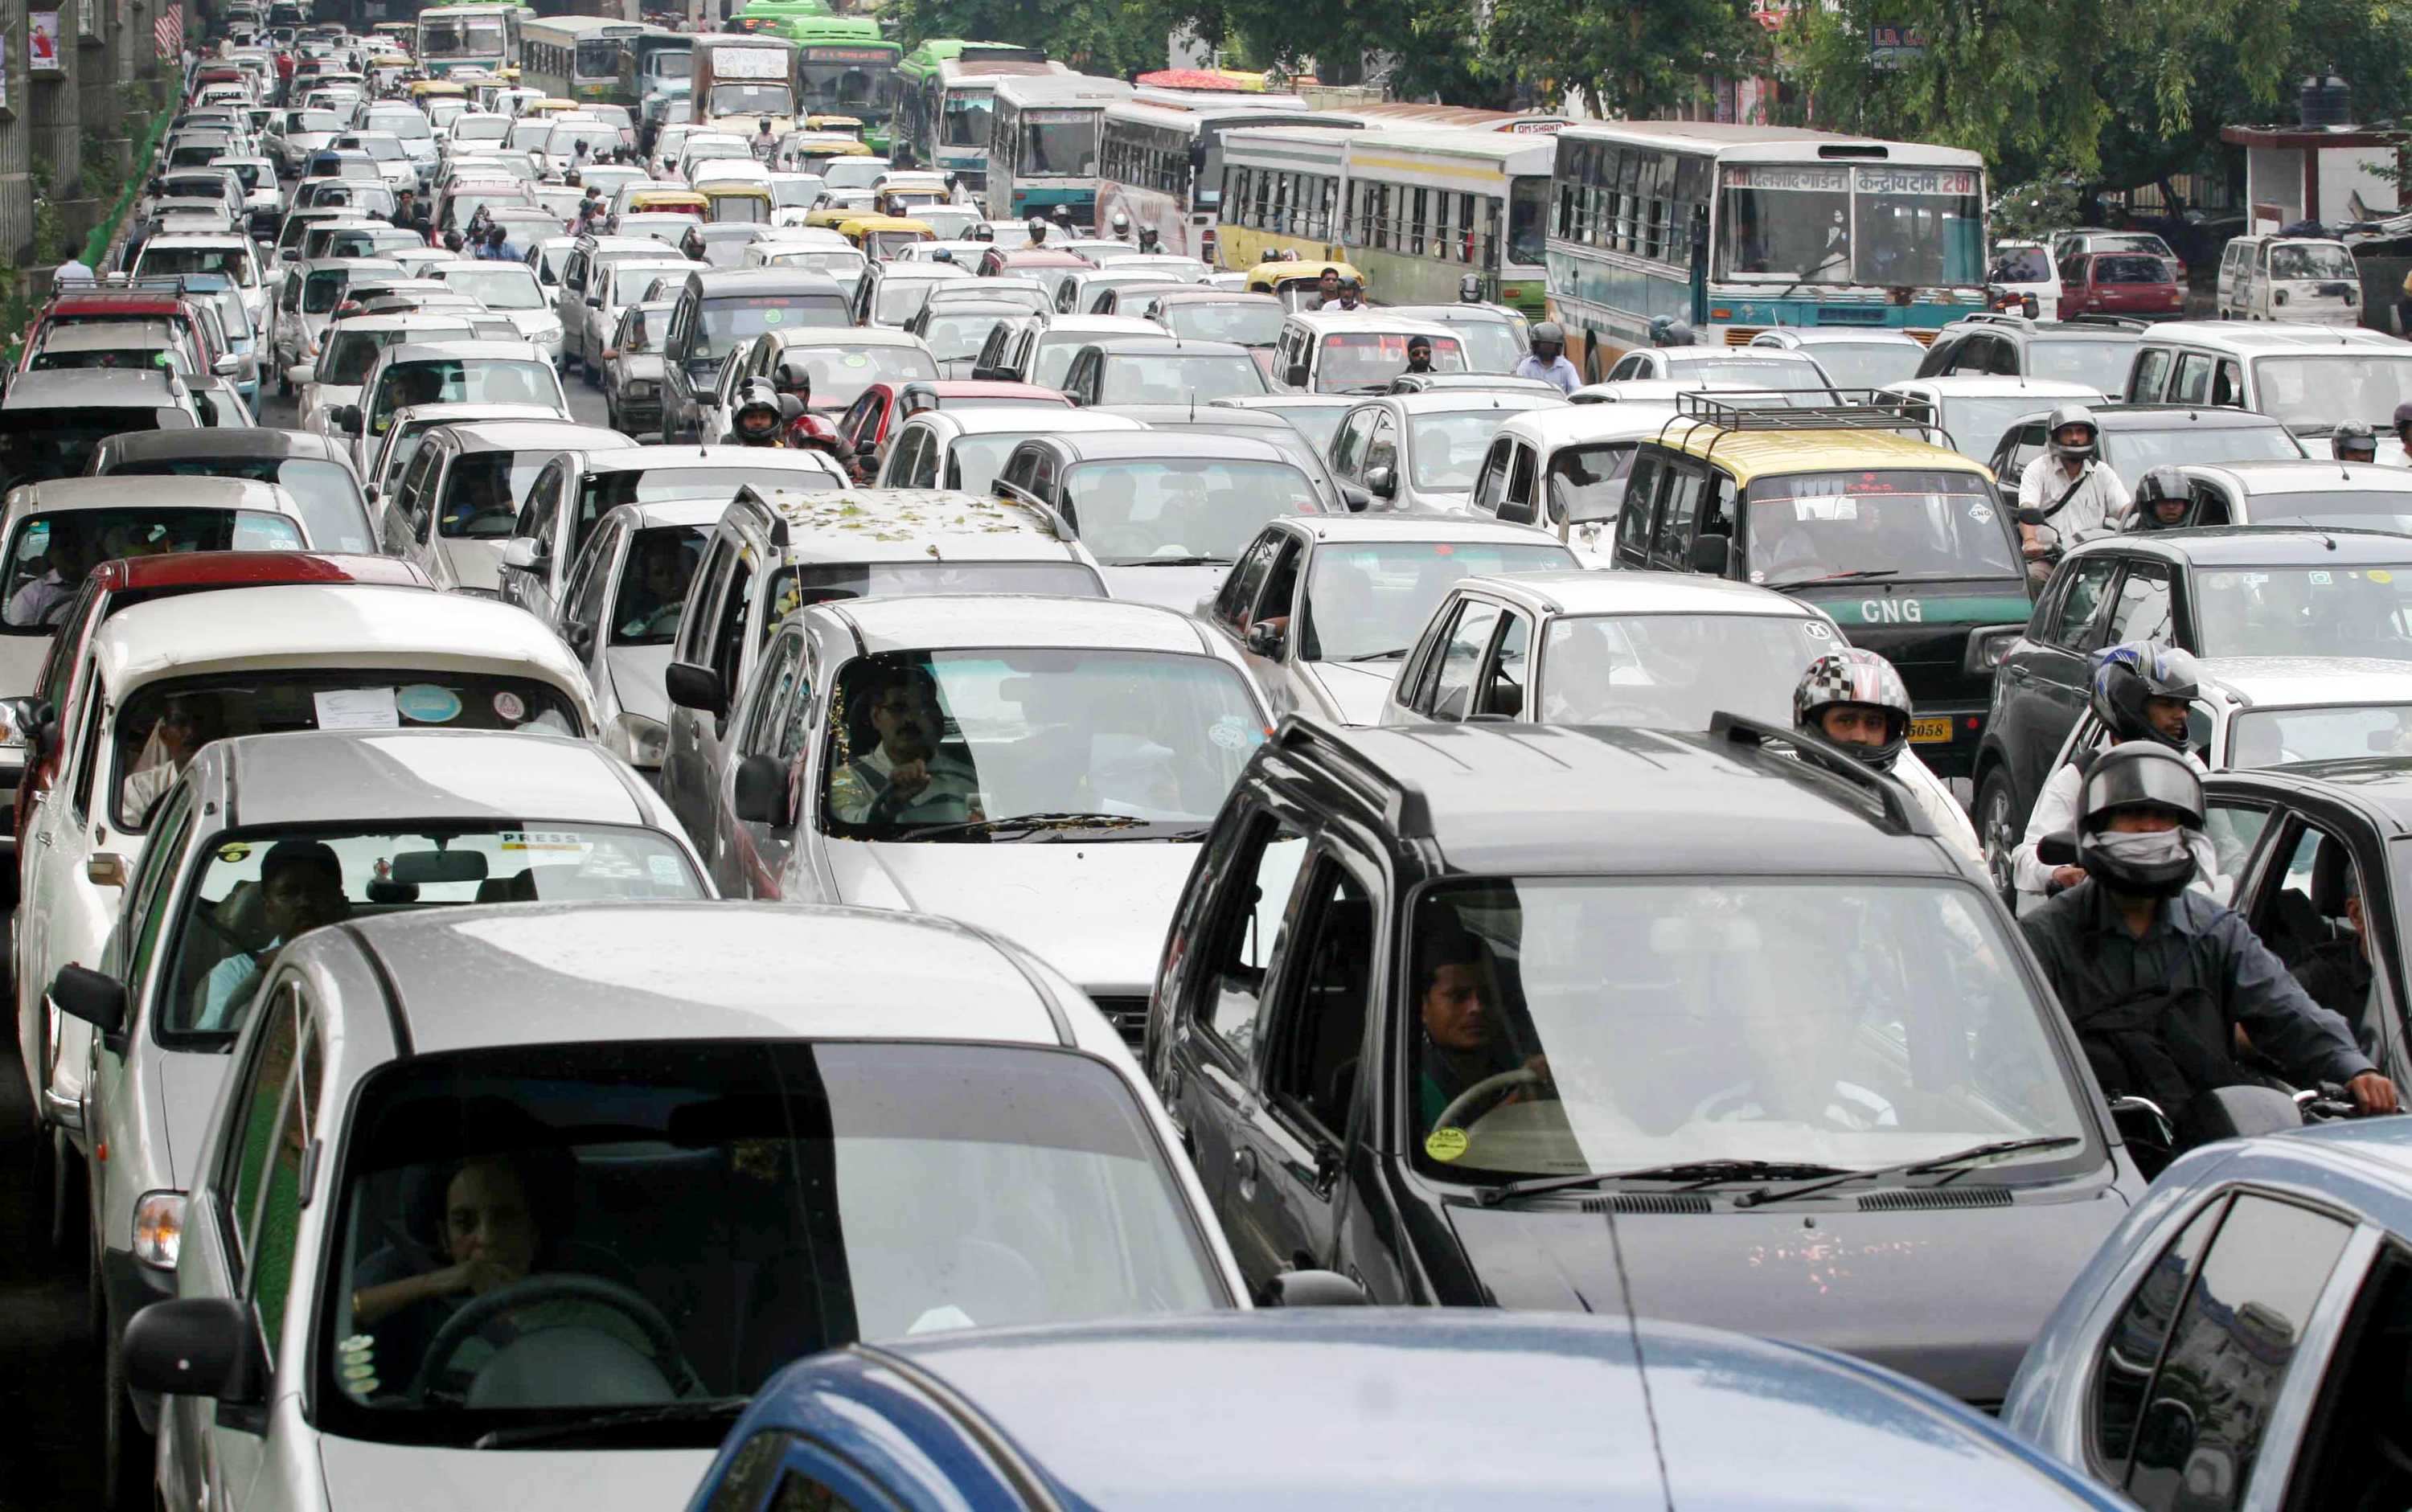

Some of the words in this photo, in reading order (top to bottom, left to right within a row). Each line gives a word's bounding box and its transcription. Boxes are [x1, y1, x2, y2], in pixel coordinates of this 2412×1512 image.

[1971, 509, 1991, 517] CNG
[1861, 598, 1922, 624] CNG
[503, 833, 578, 843] PRESS
